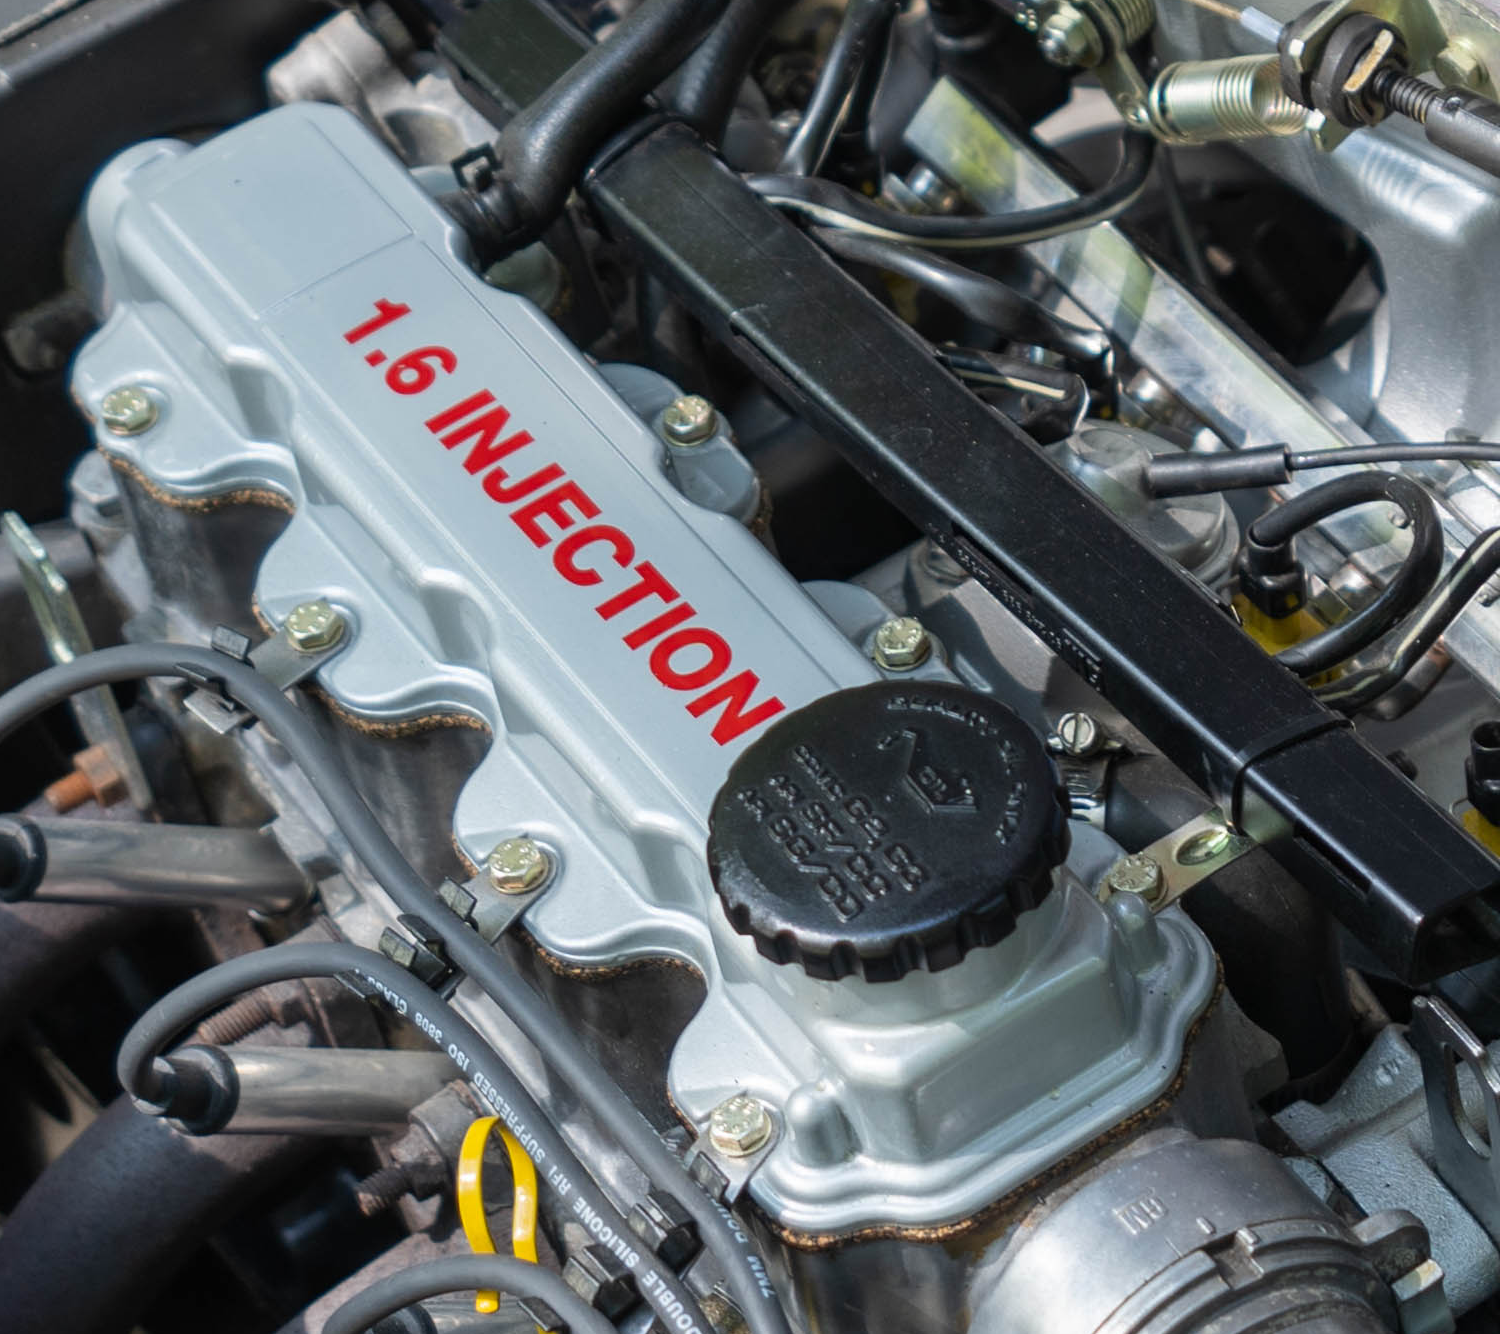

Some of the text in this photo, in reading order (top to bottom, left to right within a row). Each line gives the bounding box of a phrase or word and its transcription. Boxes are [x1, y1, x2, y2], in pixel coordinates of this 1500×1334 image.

[343, 297, 786, 747] 1.6 INJECTION
[415, 1012, 443, 1043] 3808
[448, 1043, 470, 1071] ISO
[473, 1072, 546, 1165] SUPPRESSED
[548, 1165, 572, 1196] RFI
[573, 1196, 640, 1268] SILICONE
[747, 1254, 776, 1299] 7MM
